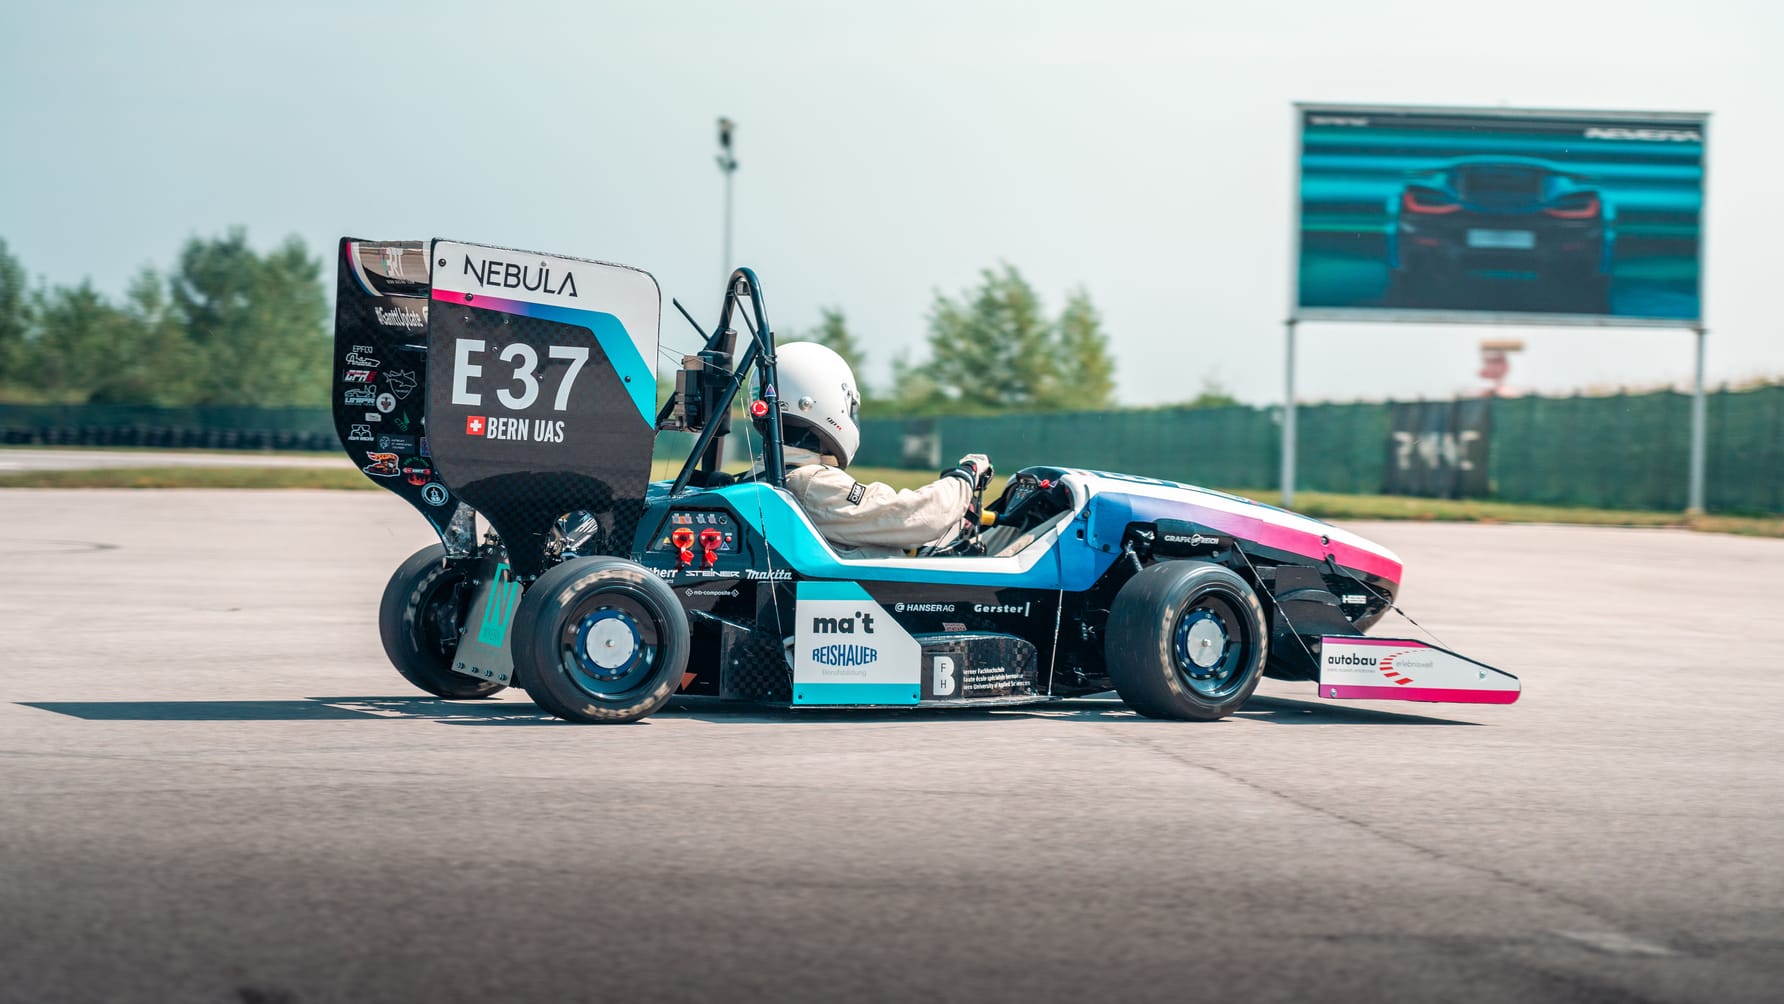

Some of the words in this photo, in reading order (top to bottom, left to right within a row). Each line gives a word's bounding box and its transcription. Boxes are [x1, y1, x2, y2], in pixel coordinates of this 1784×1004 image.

[464, 254, 578, 297] NEBULA
[487, 417, 528, 440] BERN
[534, 420, 564, 443] UAS
[974, 604, 1023, 613] Gerster
[812, 644, 877, 666] REISHAUER
[1328, 653, 1377, 665] autobau
